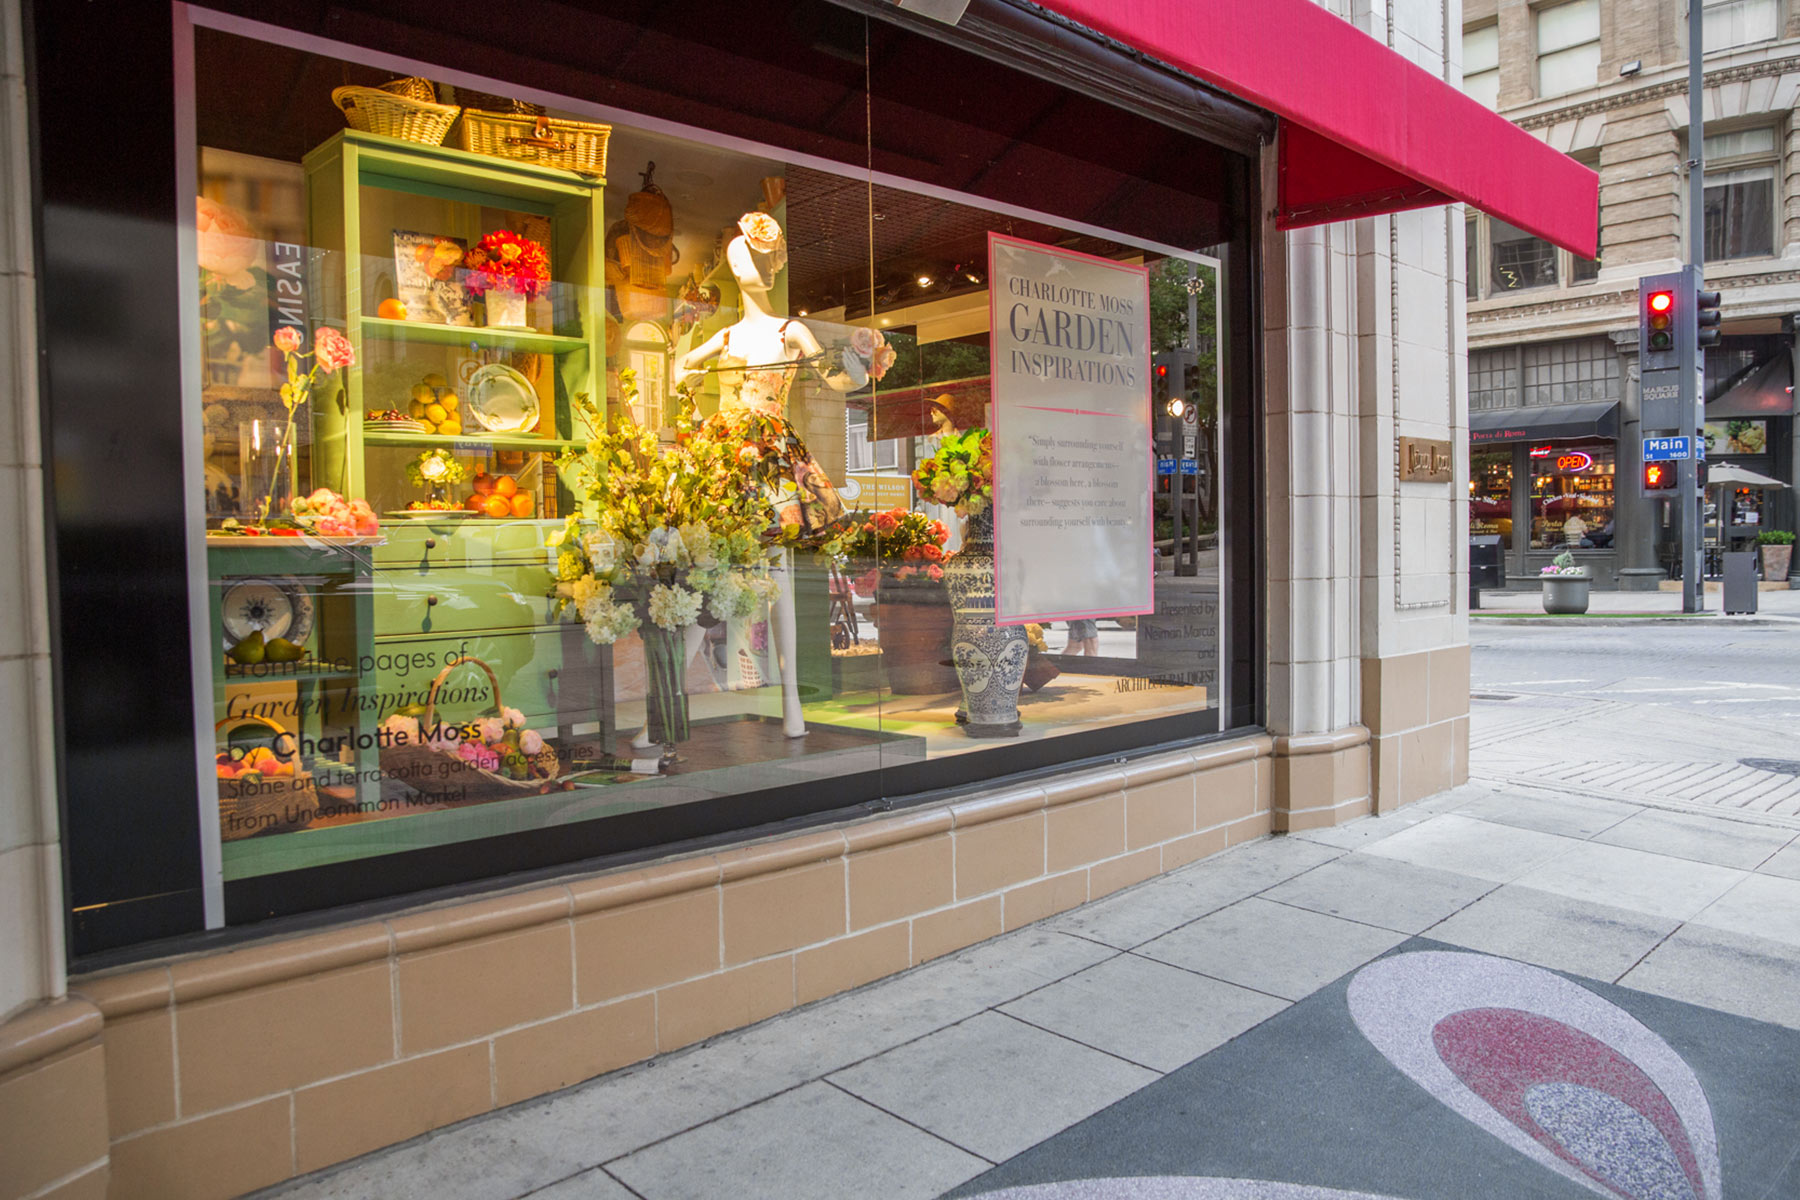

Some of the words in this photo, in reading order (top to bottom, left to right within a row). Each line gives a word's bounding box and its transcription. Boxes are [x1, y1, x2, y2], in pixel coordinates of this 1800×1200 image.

[1009, 276, 1095, 310] CHARLOTTE
[1100, 294, 1134, 316] MOSS
[1009, 303, 1134, 358] GARDEN
[1011, 350, 1135, 388] INSPIRATIONS
[1643, 385, 1679, 393] MARCUS
[1643, 391, 1679, 400] SQUARE
[1504, 430, 1526, 438] Roma
[1057, 438, 1098, 452] surrounding
[1650, 438, 1683, 450] Main
[1032, 457, 1049, 467] with
[1050, 456, 1071, 467] flower
[1557, 455, 1586, 470] OPEN
[1040, 476, 1069, 487] blossom
[1093, 478, 1119, 489] blossom
[1020, 516, 1064, 529] surrounding
[1064, 516, 1091, 529] yourself
[1091, 517, 1106, 528] with
[1160, 601, 1203, 616] Presented
[1205, 600, 1216, 617] by
[1144, 624, 1182, 640] Neiman
[1183, 625, 1216, 639] Marcus
[226, 657, 297, 679] From
[307, 650, 349, 675] the
[359, 652, 436, 679] pages
[444, 641, 469, 667] of
[1198, 645, 1216, 660] and
[1187, 669, 1216, 684] DIGEST
[226, 692, 331, 720] Garden
[341, 680, 489, 721] Inspirations
[227, 738, 262, 769] by
[272, 726, 409, 758] Charlotte
[418, 718, 482, 745] Moss
[228, 778, 285, 800] Stone
[292, 769, 331, 790] and
[337, 768, 382, 787] terra
[388, 761, 433, 781] cotta
[440, 752, 500, 777] garden
[507, 744, 594, 767] accessories
[228, 812, 279, 832] from
[285, 793, 400, 824] Uncommon
